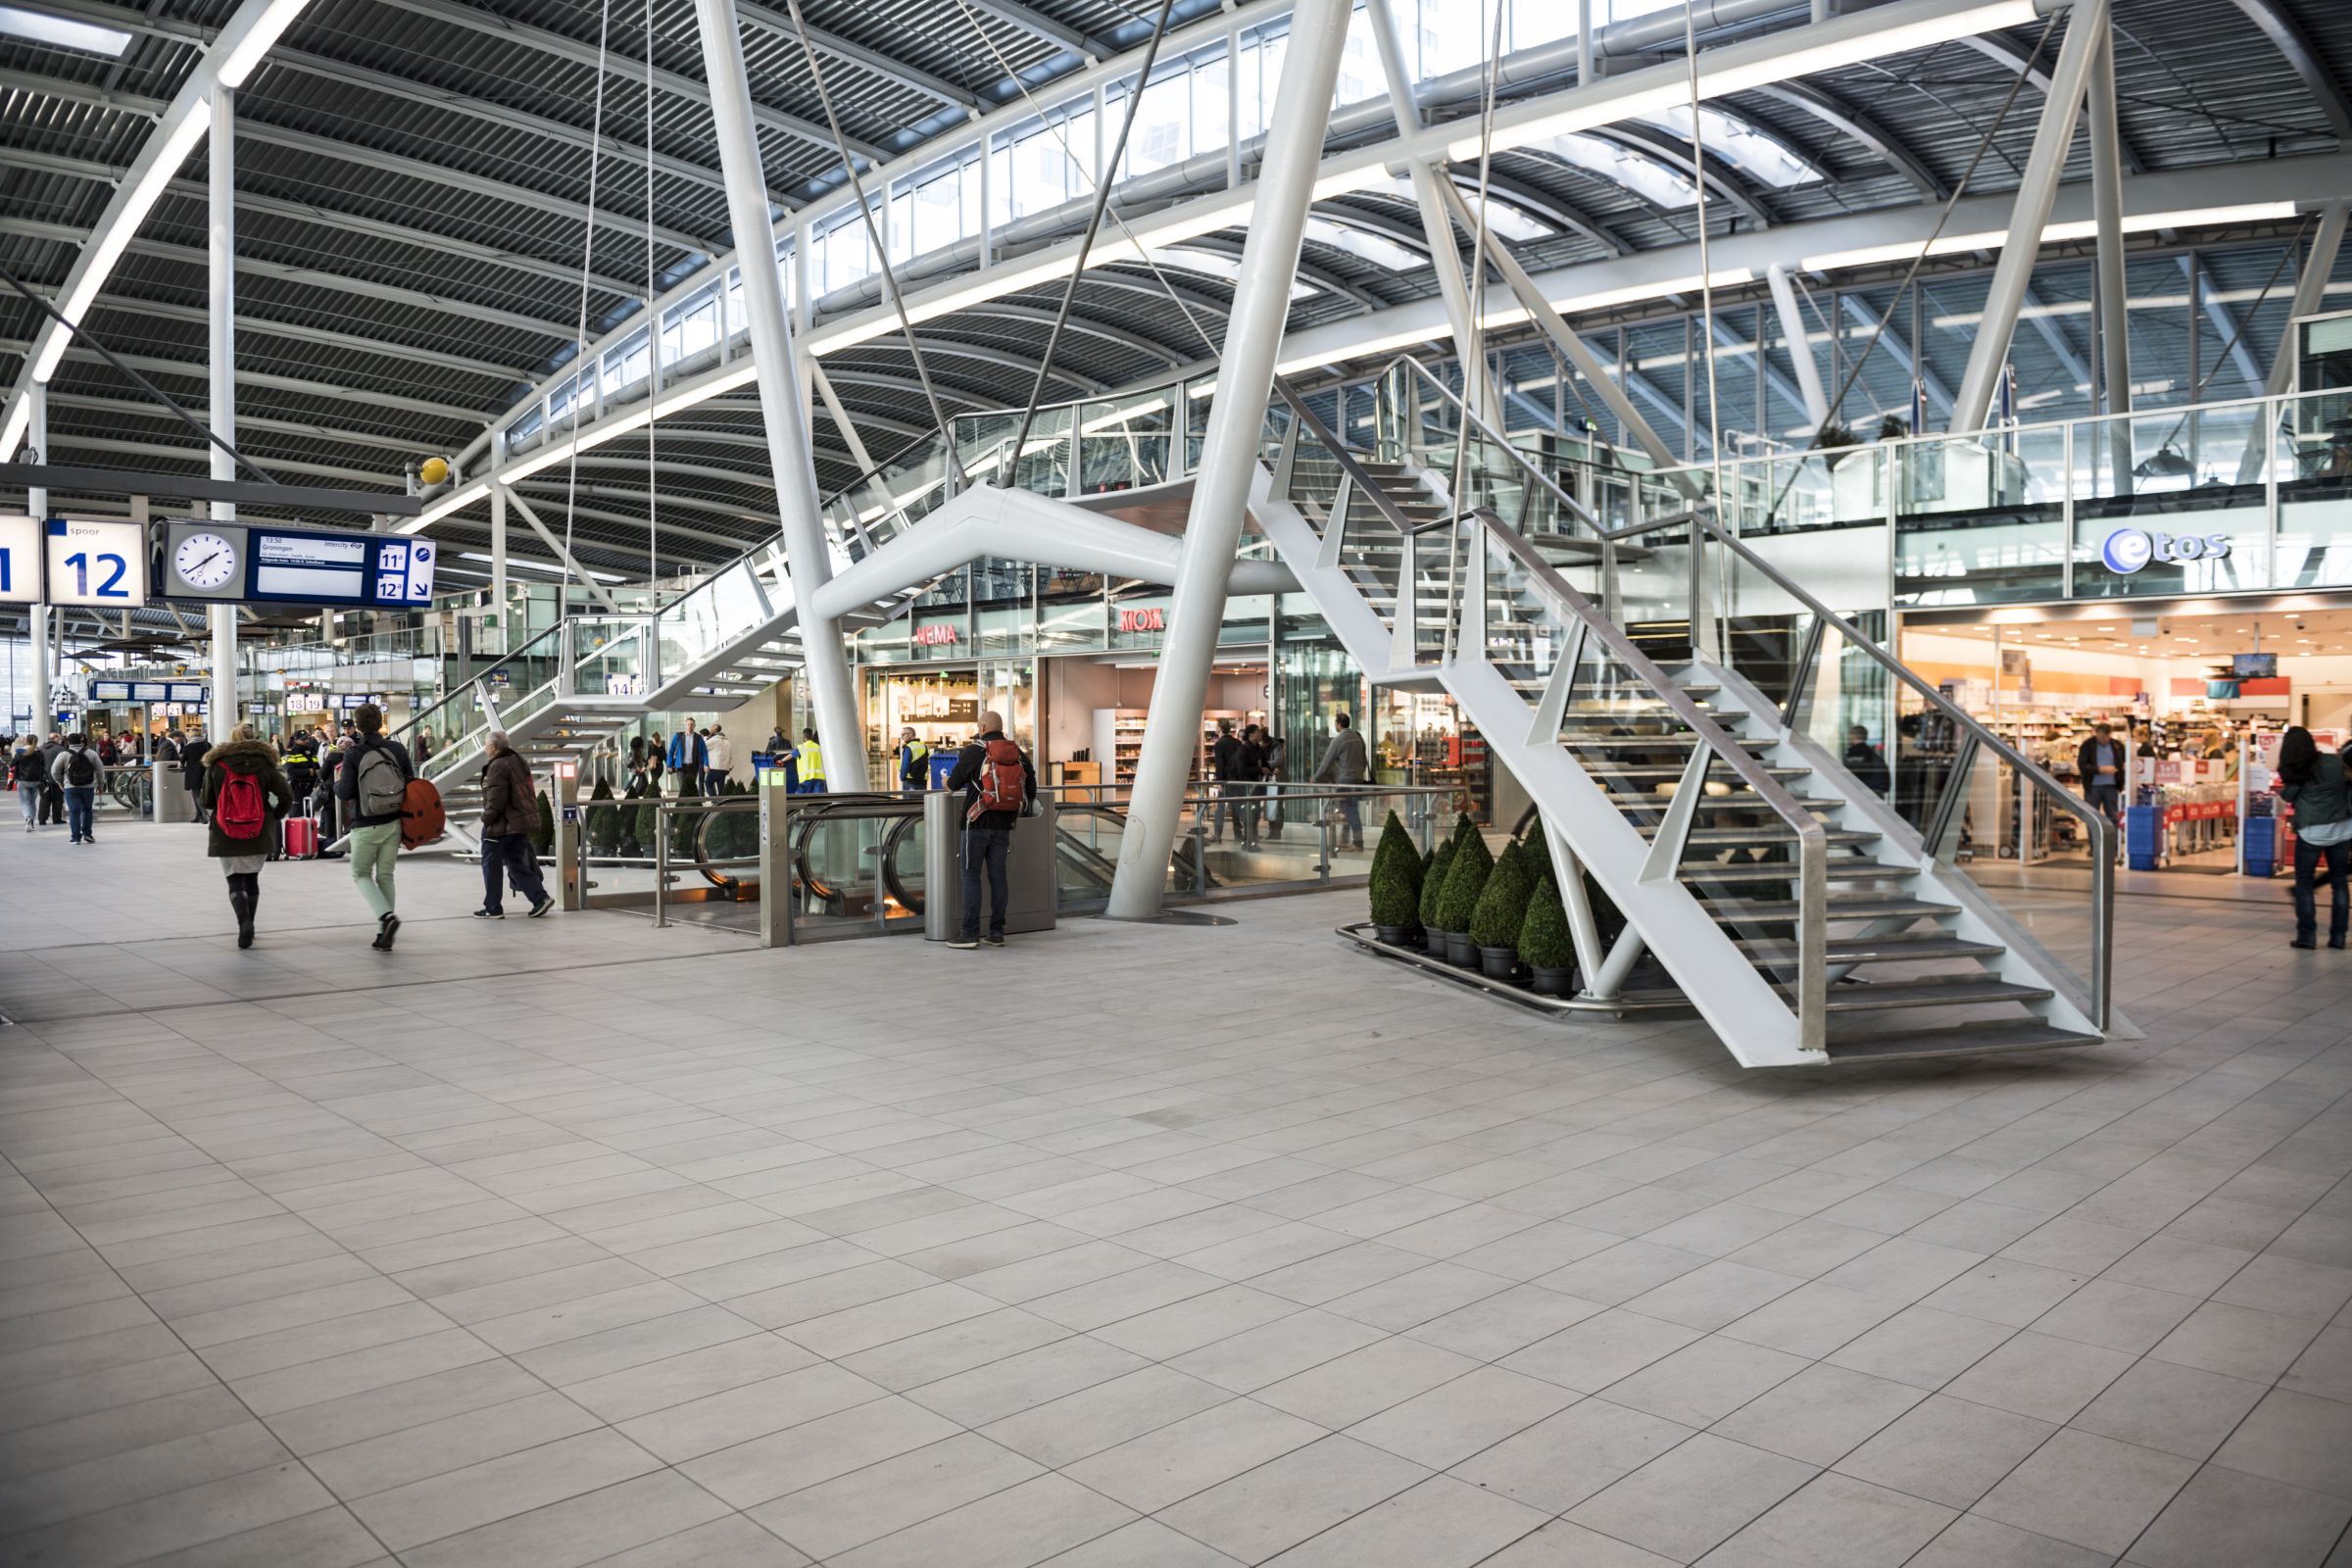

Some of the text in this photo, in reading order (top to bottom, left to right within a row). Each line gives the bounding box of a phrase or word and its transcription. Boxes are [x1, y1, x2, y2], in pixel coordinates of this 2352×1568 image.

[71, 527, 100, 536] spoor
[2103, 529, 2229, 571] etos
[64, 553, 129, 597] 12
[1121, 608, 1163, 631] KIOSK
[916, 624, 957, 645] HEMA
[613, 683, 628, 695] 14
[290, 700, 303, 710] 18
[309, 700, 320, 710] 19
